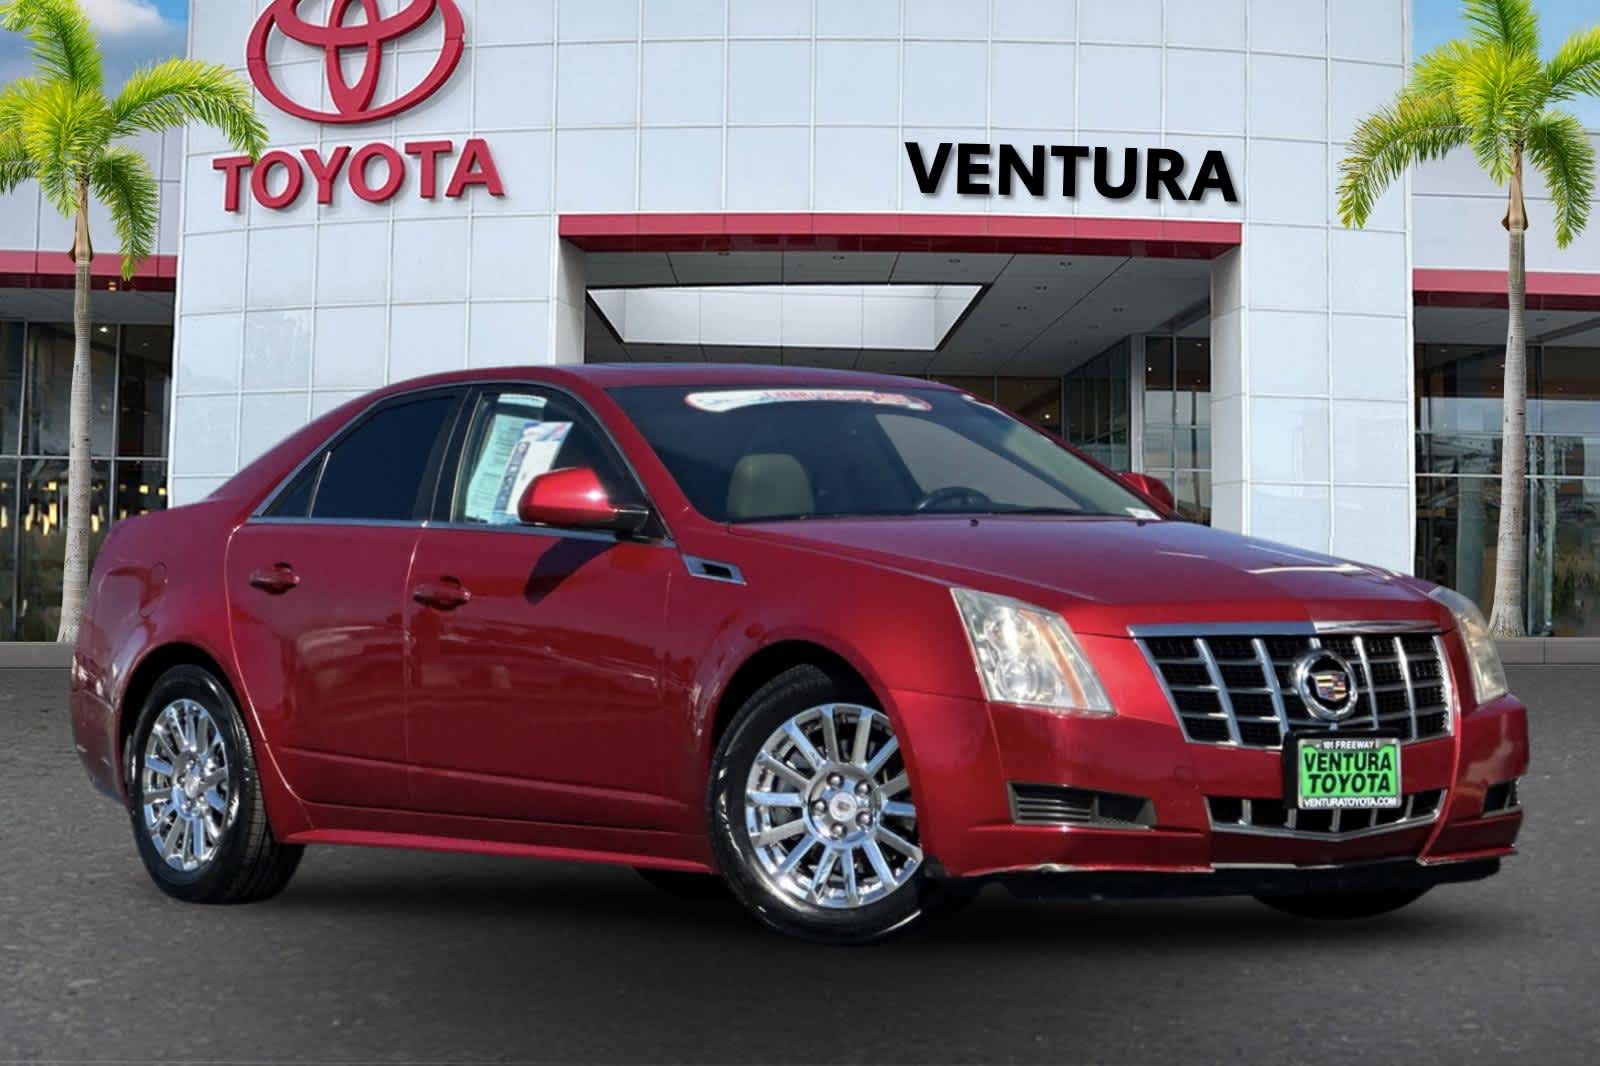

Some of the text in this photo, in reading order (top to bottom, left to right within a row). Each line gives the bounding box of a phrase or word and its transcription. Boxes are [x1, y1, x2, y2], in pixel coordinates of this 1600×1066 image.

[213, 139, 505, 212] TOYOTA
[904, 141, 1240, 202] VENTURA
[1335, 740, 1375, 750] FREEWAY
[1304, 752, 1392, 772] VENTURA
[1308, 773, 1391, 793] TOYOTA
[1303, 797, 1397, 807] VENTURATOYOTA.COM
